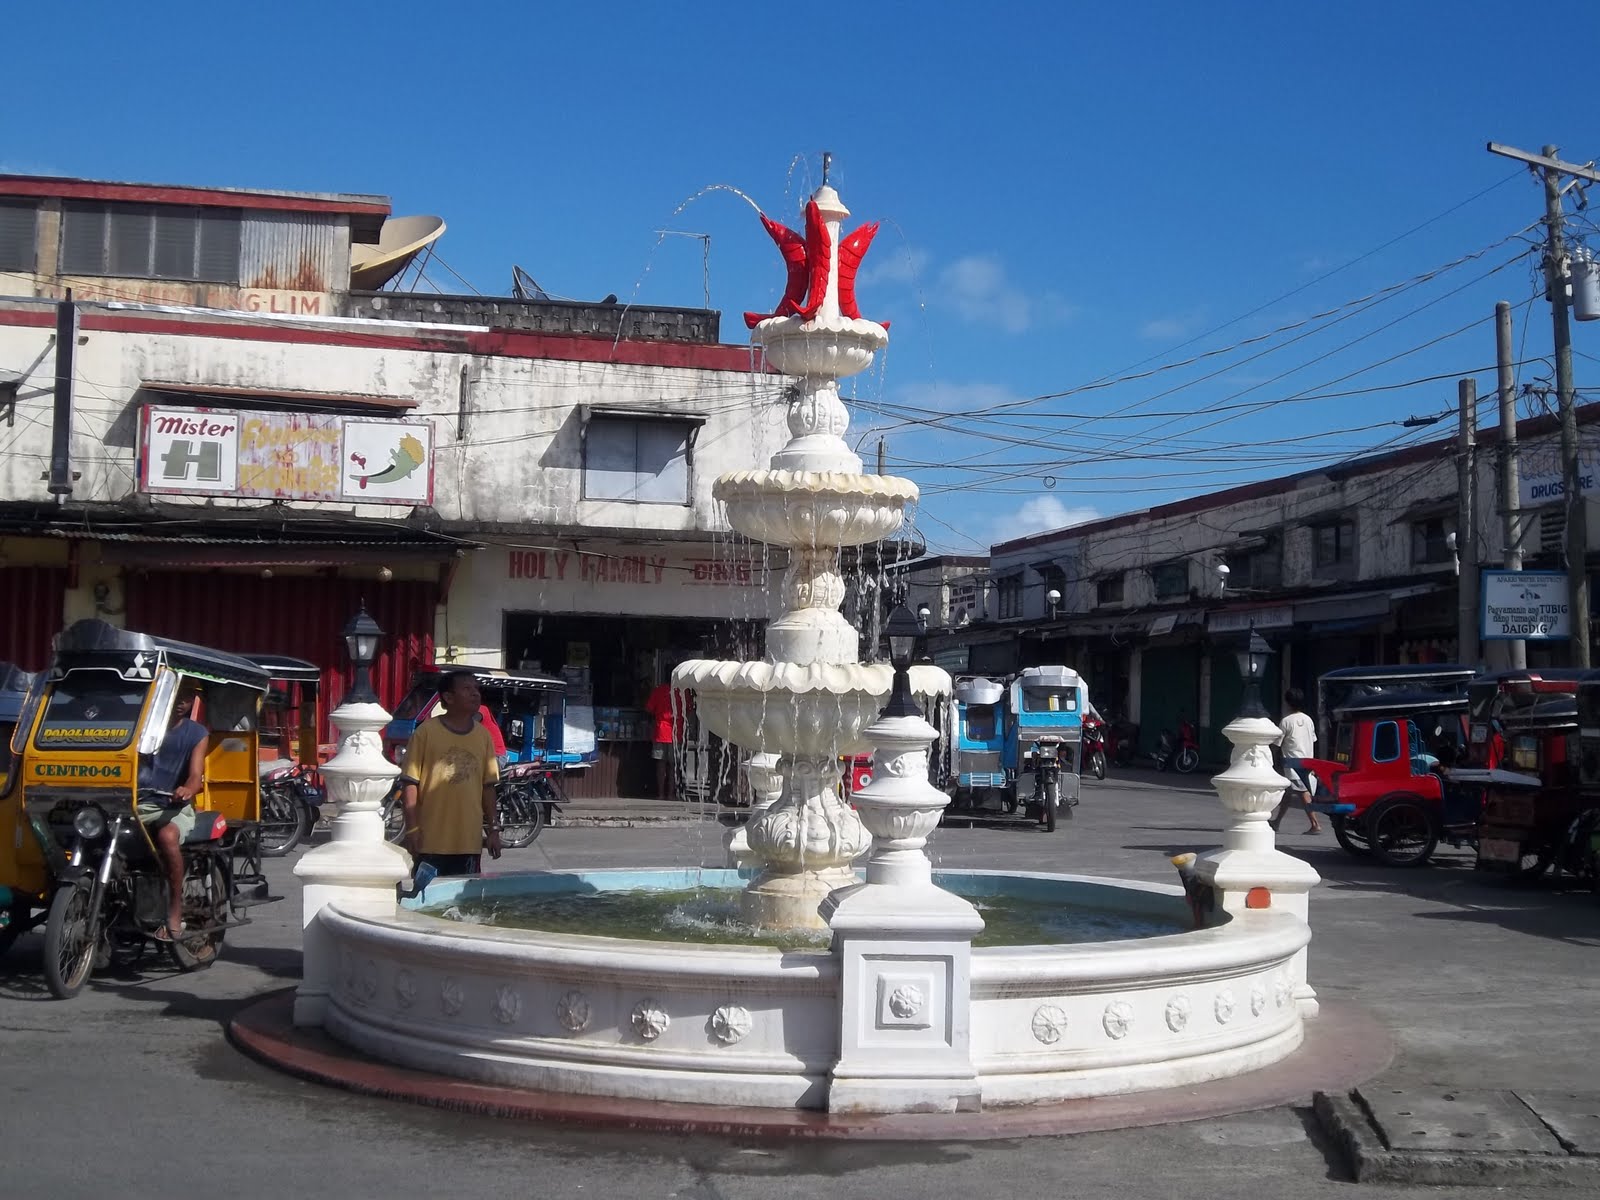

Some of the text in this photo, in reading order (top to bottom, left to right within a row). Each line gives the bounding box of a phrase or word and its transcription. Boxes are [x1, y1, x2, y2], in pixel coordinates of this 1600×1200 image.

[154, 416, 235, 437] Mister
[161, 439, 222, 482] H
[1531, 475, 1593, 499] DRUGSRE
[509, 551, 568, 580] HOLY
[580, 553, 666, 584] FAMILY
[1540, 604, 1568, 614] TUBIG
[35, 764, 122, 777] CENTRO-04
